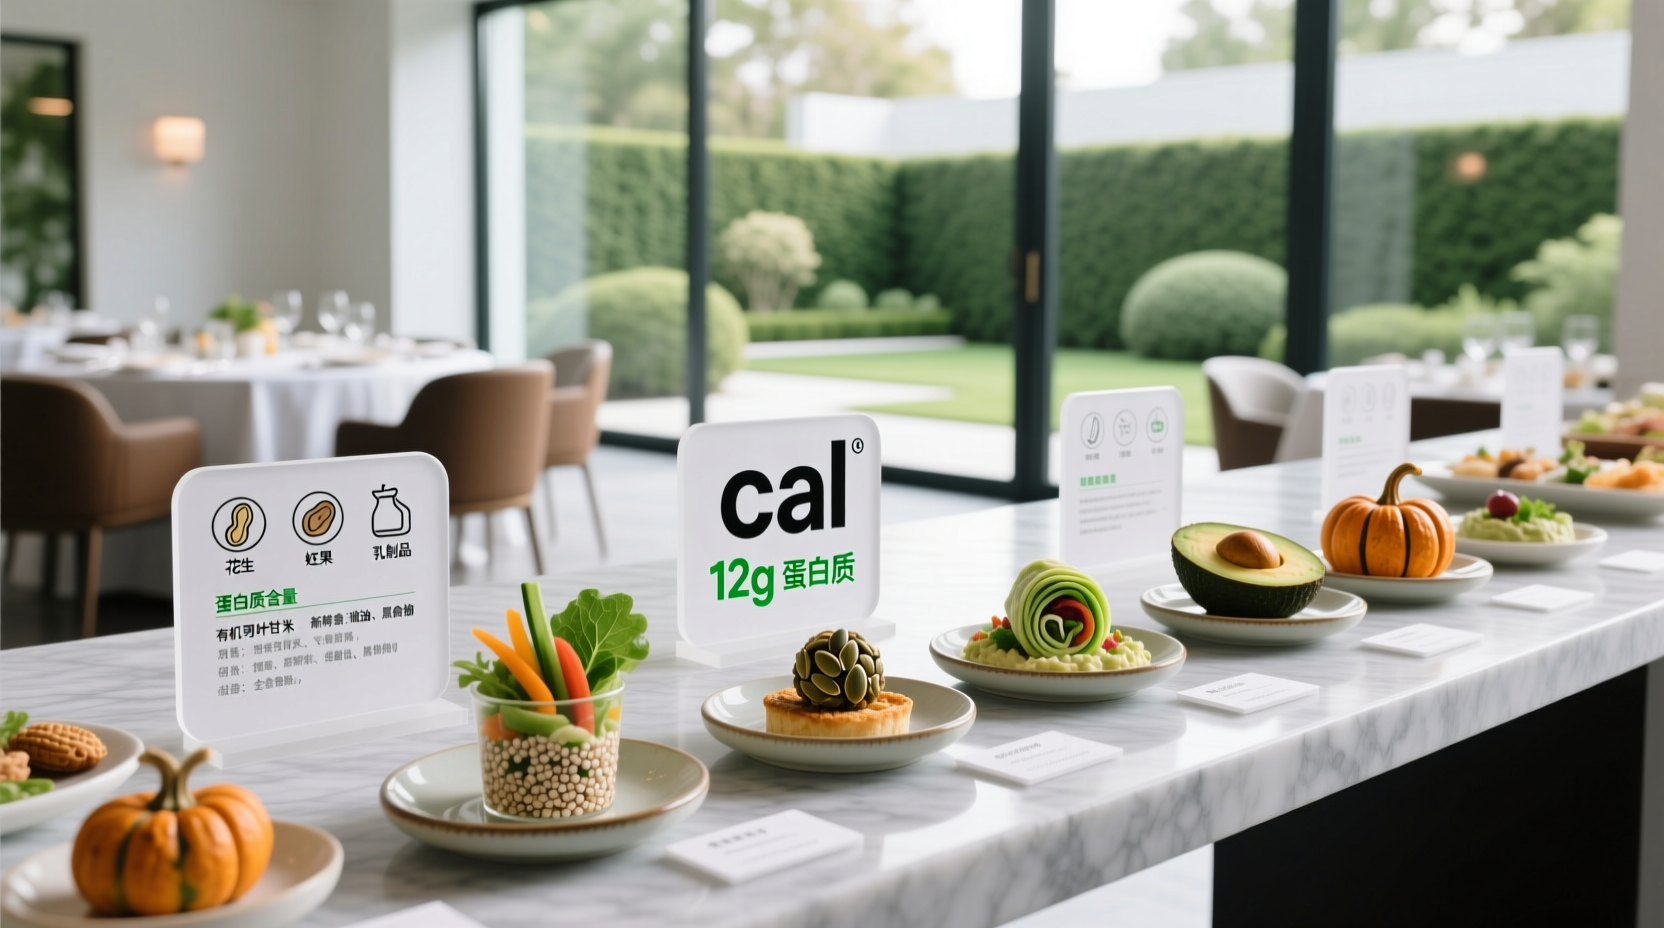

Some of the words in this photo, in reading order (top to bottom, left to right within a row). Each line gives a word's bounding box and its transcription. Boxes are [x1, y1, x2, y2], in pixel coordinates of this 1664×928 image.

[721, 440, 845, 539] cal
[224, 557, 255, 576] 花生
[710, 558, 774, 607] 12g
[782, 551, 856, 590] 蛋白质
